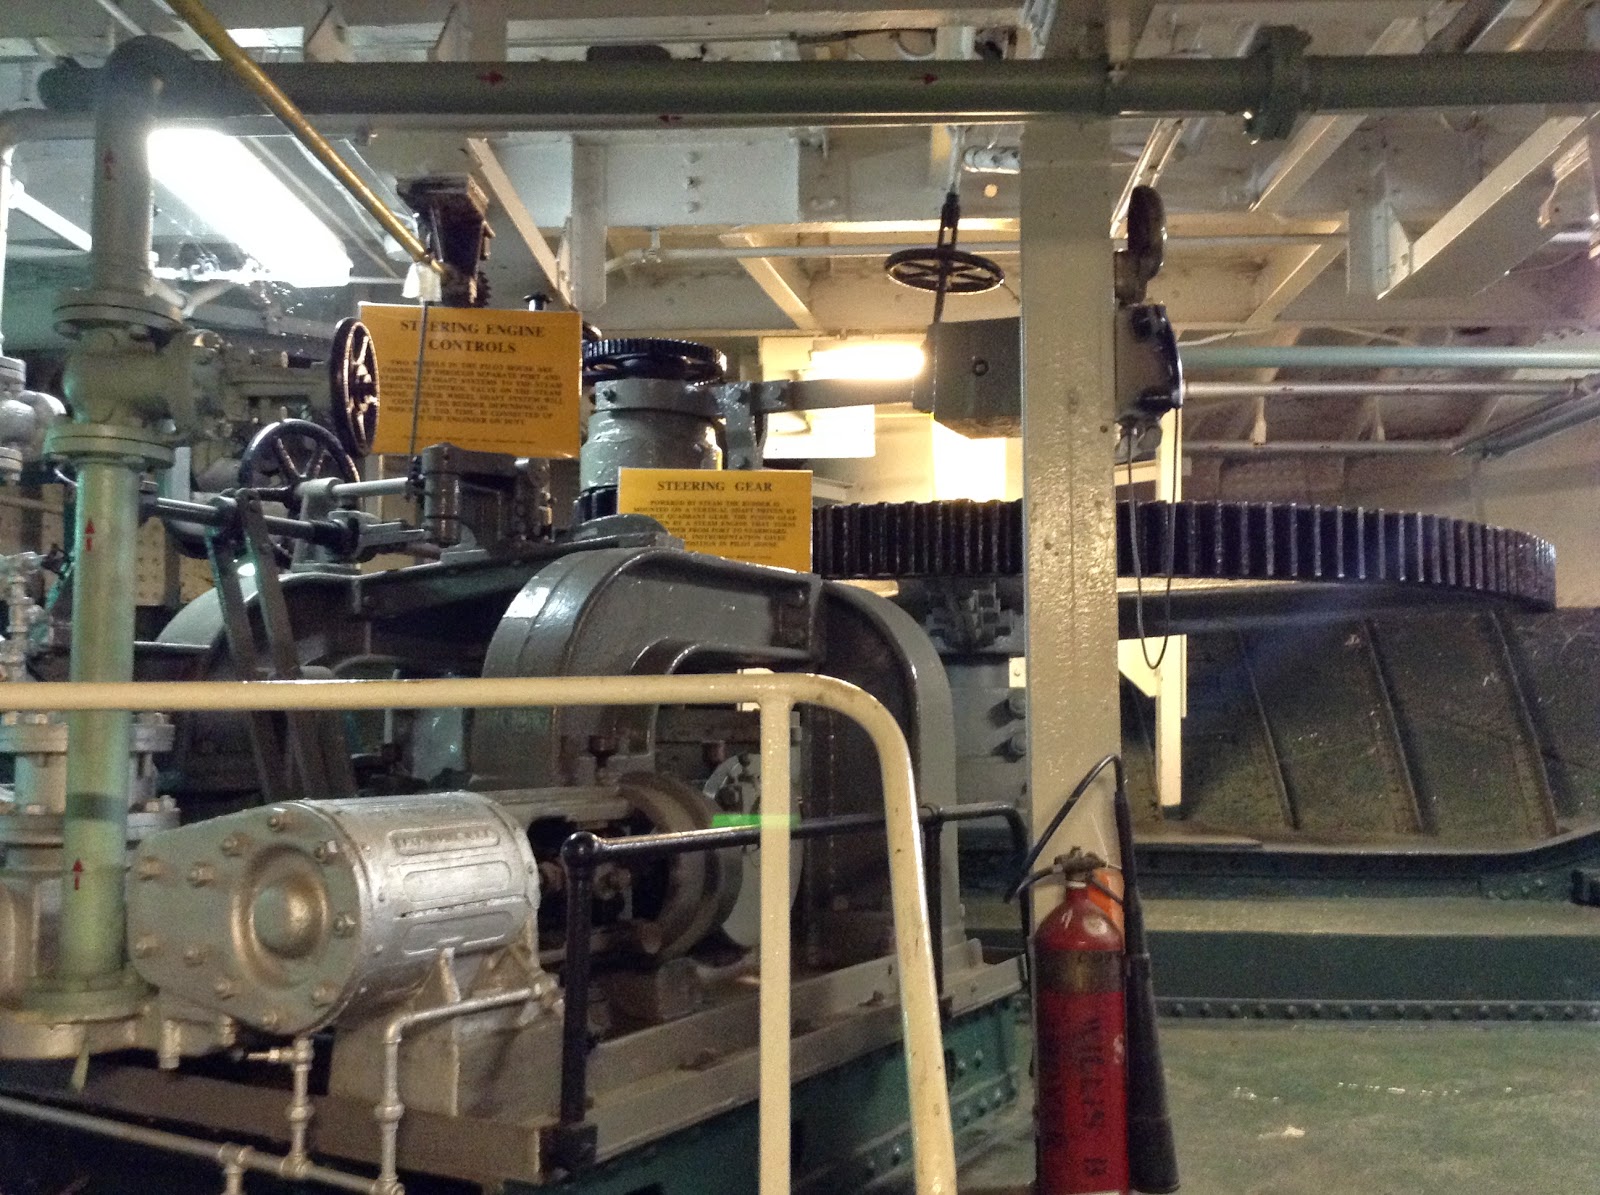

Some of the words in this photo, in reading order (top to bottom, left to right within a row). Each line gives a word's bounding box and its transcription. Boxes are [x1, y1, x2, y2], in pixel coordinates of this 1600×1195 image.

[401, 320, 479, 333] STERING
[486, 324, 546, 337] ENGINE
[428, 339, 517, 353] CONTROLS
[657, 480, 725, 491] STEERING
[735, 481, 773, 492] GEAR
